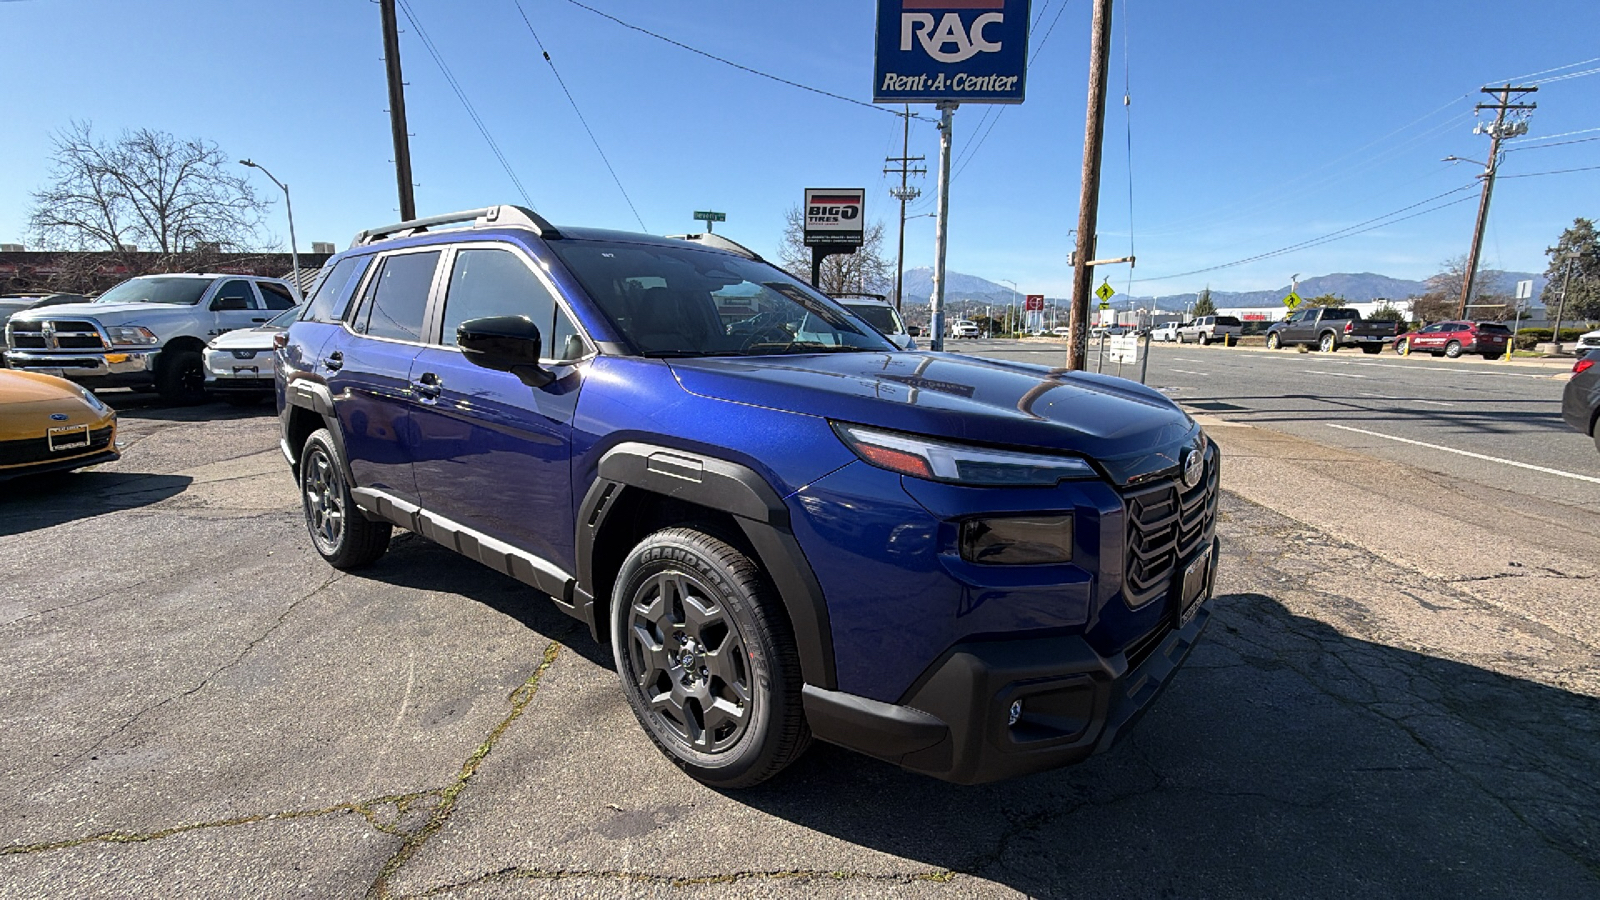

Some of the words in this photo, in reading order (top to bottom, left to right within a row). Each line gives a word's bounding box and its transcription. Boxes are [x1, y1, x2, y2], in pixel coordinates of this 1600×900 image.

[900, 12, 1004, 63] RAC
[808, 206, 840, 216] BIG
[641, 548, 743, 613] GRANDTREK
